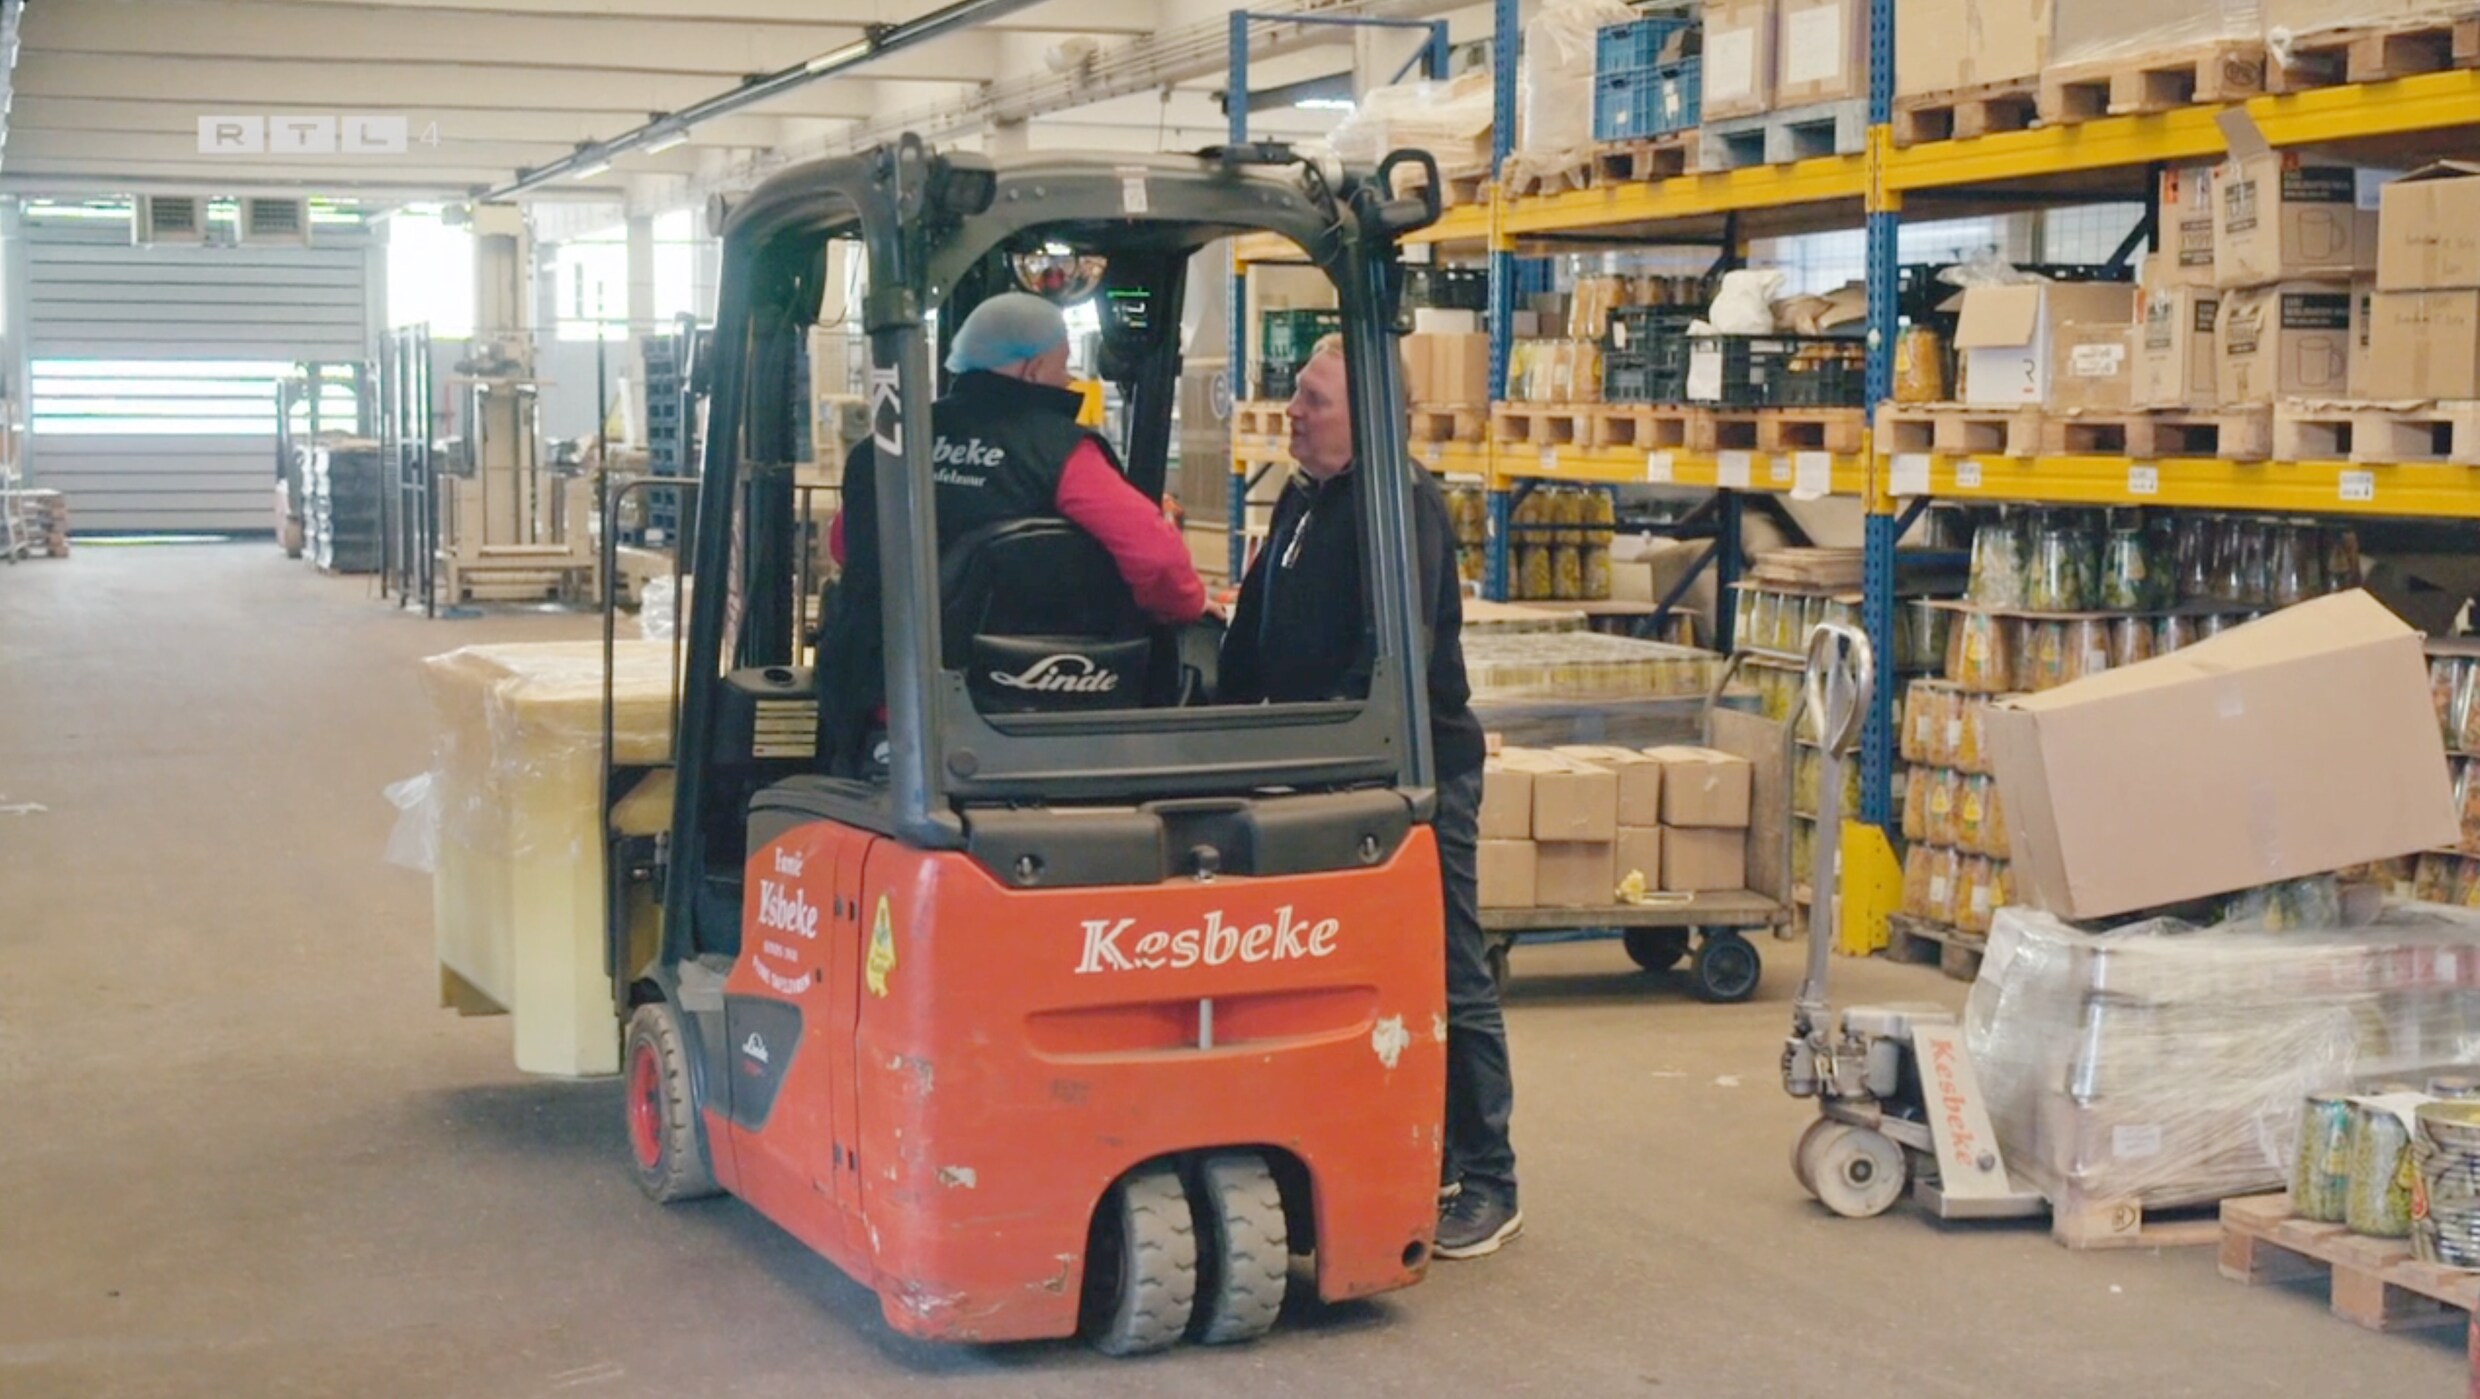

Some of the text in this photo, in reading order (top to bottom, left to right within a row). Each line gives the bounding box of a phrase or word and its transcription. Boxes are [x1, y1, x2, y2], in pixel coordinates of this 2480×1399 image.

[988, 653, 1119, 693] Linde
[1073, 903, 1340, 974] Kesbeke
[1929, 1038, 1976, 1167] Kesbeke
